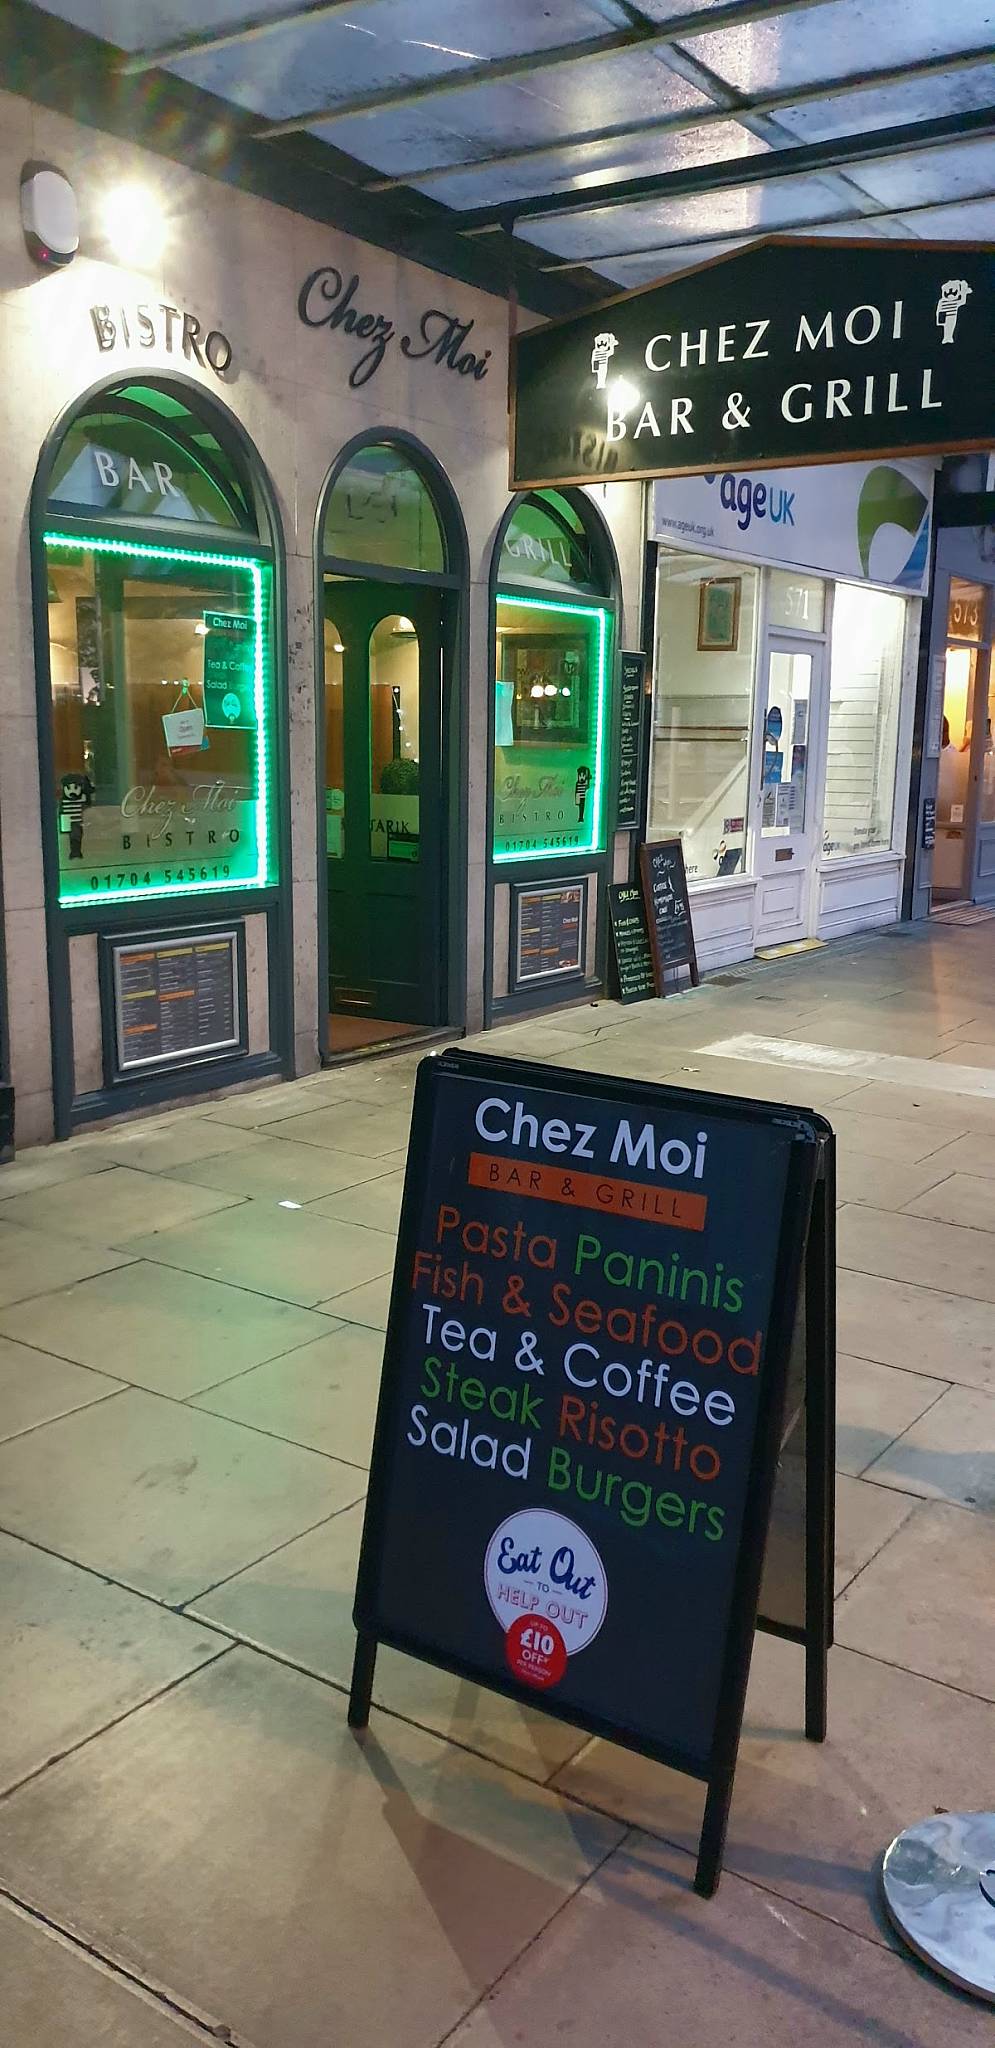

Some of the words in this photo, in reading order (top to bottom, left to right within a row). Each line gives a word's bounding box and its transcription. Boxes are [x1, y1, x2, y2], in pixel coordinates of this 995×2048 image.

[89, 304, 233, 373] BISTRO
[298, 266, 395, 388] Chez
[400, 309, 491, 382] Moi
[645, 320, 771, 372] CHEZ
[795, 300, 904, 352] MOI
[606, 397, 695, 442] BAR
[721, 391, 751, 430] &
[781, 368, 943, 424] GRILL
[94, 450, 180, 497] BAR
[504, 533, 573, 568] GRILL
[213, 617, 231, 629] Chez
[232, 619, 248, 630] Moi
[785, 586, 809, 620] 571
[953, 602, 979, 626] 573
[206, 680, 227, 690] Salad
[121, 784, 177, 840] Chez
[182, 781, 239, 814] Moi
[498, 810, 565, 824] BISTRO
[122, 829, 240, 850] BISTRO
[505, 839, 537, 852] 01704
[91, 871, 151, 891] 01704
[164, 865, 231, 884] 545619
[474, 1096, 598, 1159] Chez
[609, 1119, 708, 1179] Moi
[489, 1163, 542, 1191] BAR
[561, 1177, 575, 1197] &
[595, 1183, 682, 1219] GRILL
[435, 1204, 558, 1270] Pasta
[574, 1233, 745, 1313] Paninis
[411, 1250, 486, 1305] Fish
[502, 1275, 531, 1319] &
[548, 1282, 764, 1377] Seafood
[422, 1303, 497, 1362] Tea
[514, 1331, 545, 1376] &
[563, 1342, 736, 1427] Coffee
[420, 1356, 545, 1429] Steak
[558, 1394, 721, 1482] Risotto
[406, 1404, 532, 1481] Salad
[546, 1446, 727, 1542] Burgers
[497, 1536, 543, 1574] Eat
[549, 1546, 597, 1600] Out
[537, 1581, 550, 1594] TO
[497, 1584, 540, 1611] HELP
[545, 1600, 589, 1629] OUT
[520, 1628, 555, 1655] £10
